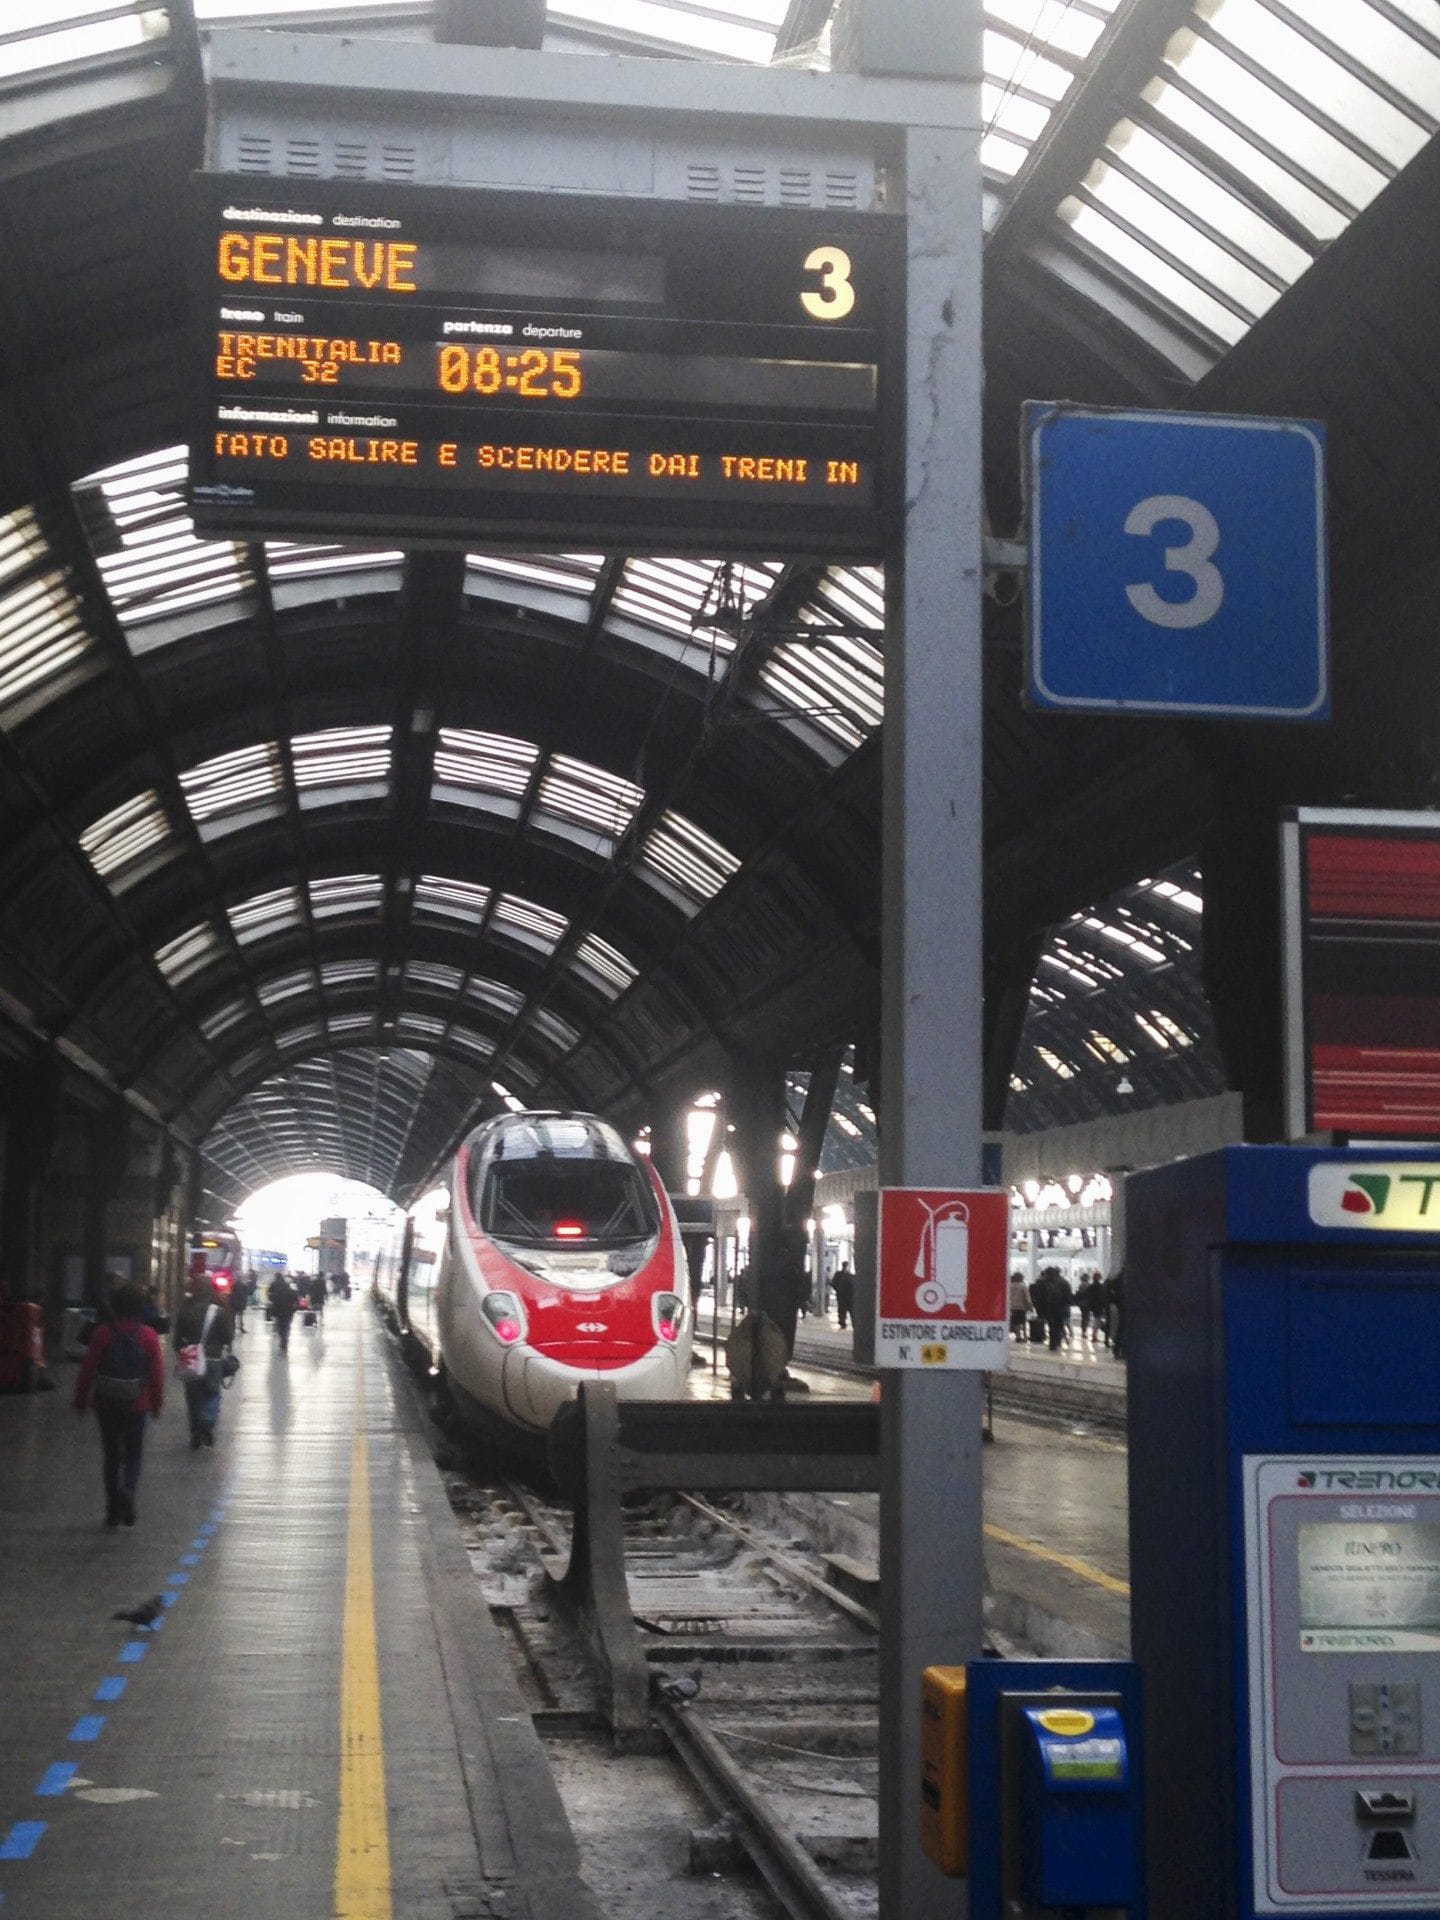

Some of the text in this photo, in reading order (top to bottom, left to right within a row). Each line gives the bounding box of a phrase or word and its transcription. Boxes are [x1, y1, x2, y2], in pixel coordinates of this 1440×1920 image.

[222, 206, 402, 230] destinazione destination
[217, 231, 419, 292] GENEVE
[800, 246, 856, 321] 3
[220, 306, 305, 324] treno train
[442, 320, 584, 341] partenza departure
[216, 332, 402, 365] TRENITALIA
[214, 354, 341, 383] EC 32
[437, 344, 583, 398] 08:25
[218, 405, 398, 428] informazioni information
[308, 435, 419, 465] SALIRE
[438, 442, 458, 467] E
[478, 444, 631, 475] SCENDERE
[650, 451, 700, 477] DAI
[721, 455, 808, 482] TRENI
[825, 459, 859, 484] IN
[1122, 494, 1226, 630] 3
[882, 1322, 1004, 1342] ESTINTORE CARRELLATO
[1319, 1470, 1440, 1489] TRENOR
